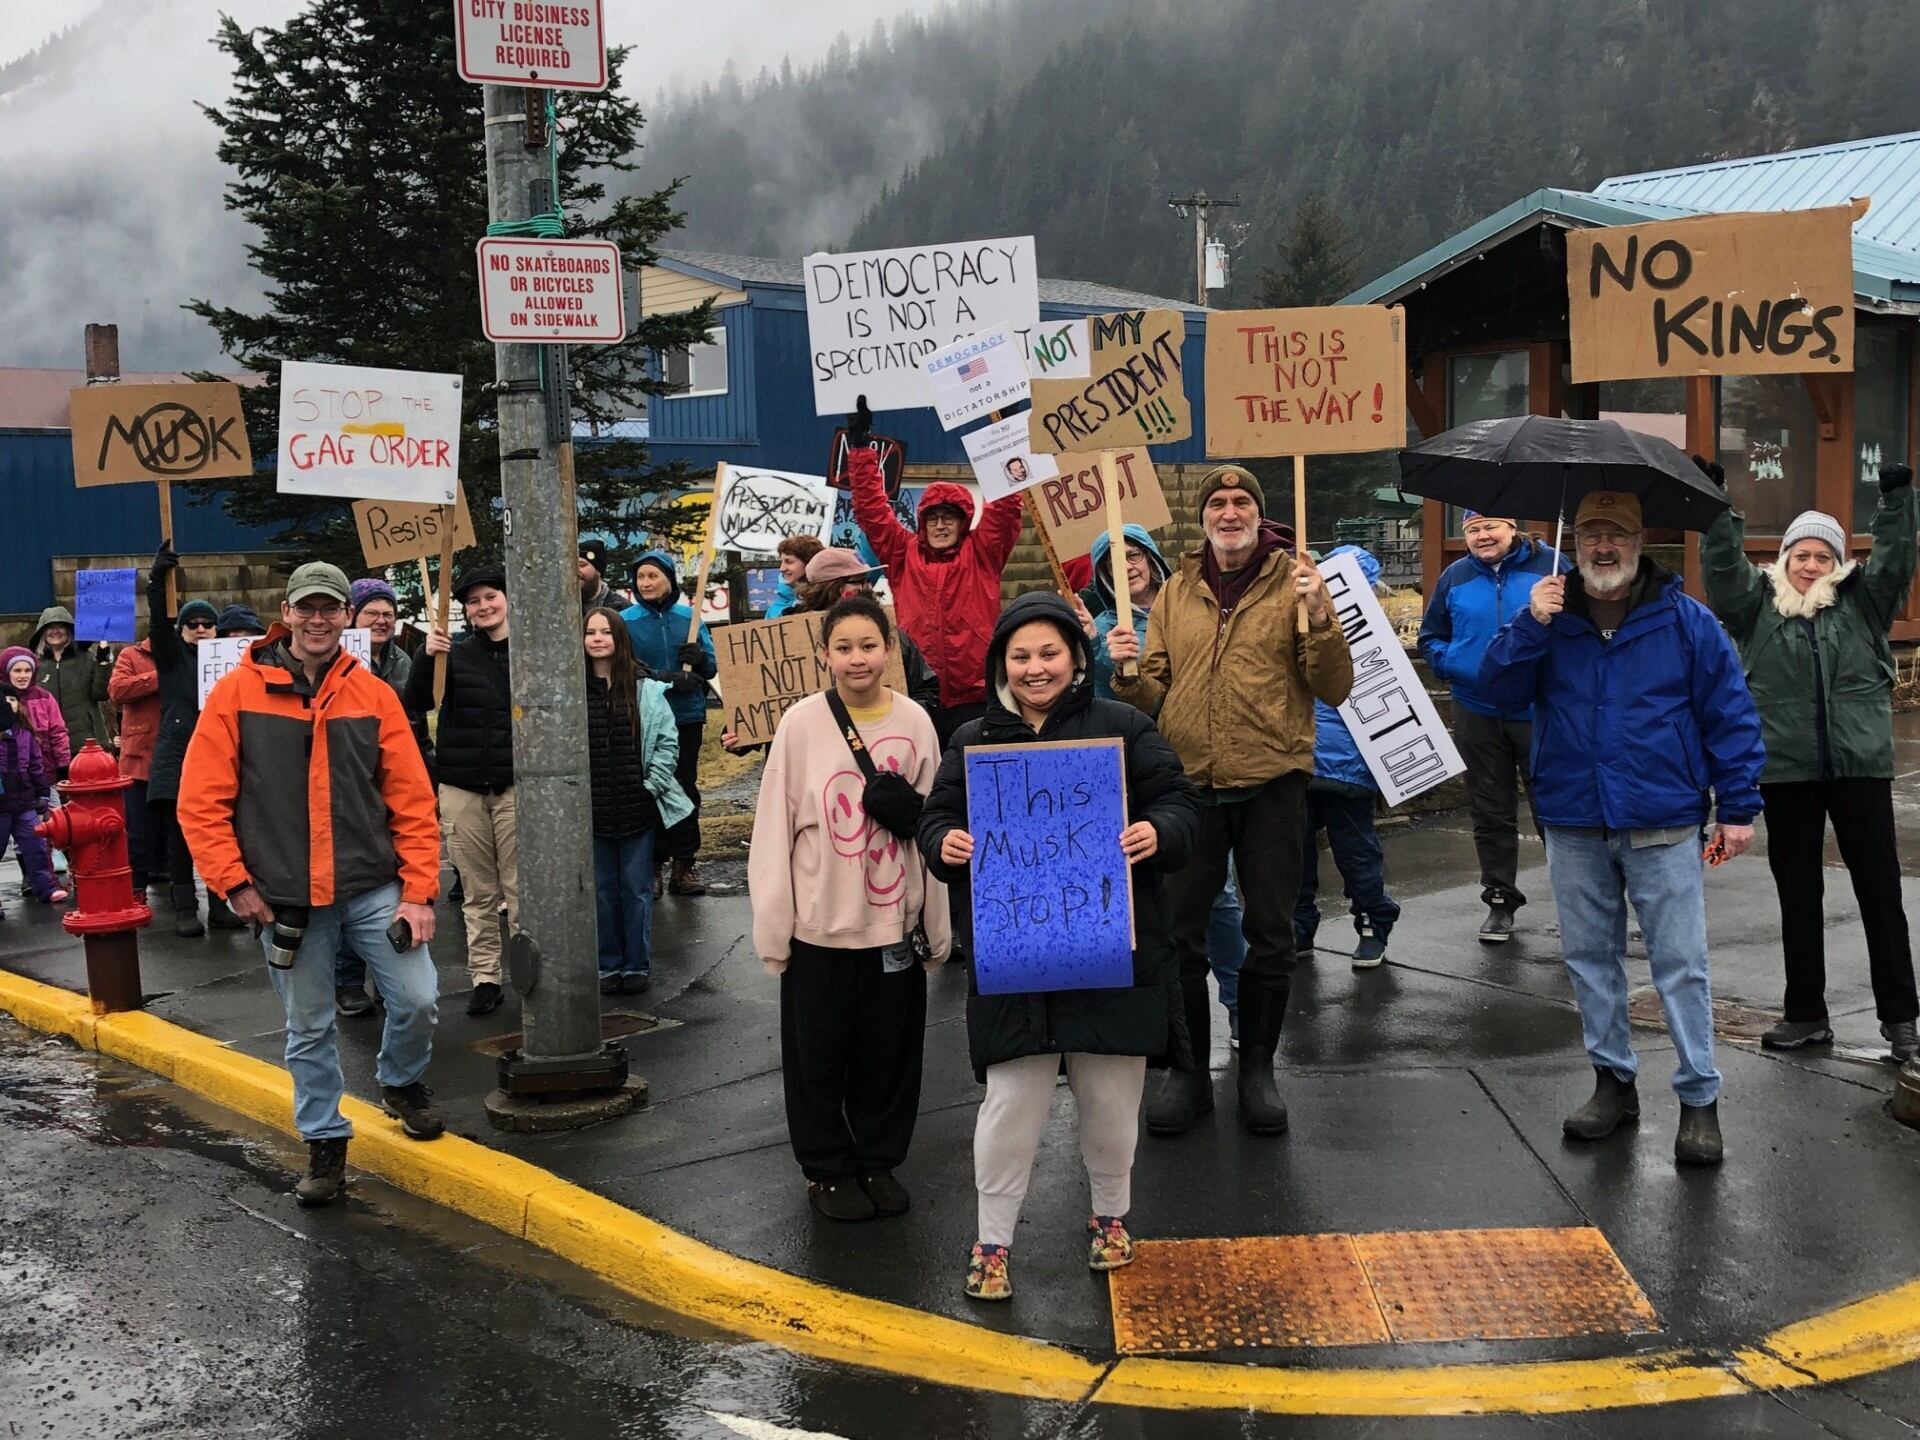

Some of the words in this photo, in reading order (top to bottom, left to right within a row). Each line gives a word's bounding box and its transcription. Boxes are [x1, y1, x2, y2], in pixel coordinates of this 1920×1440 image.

[471, 0, 505, 19] CITY
[514, 2, 590, 27] BUSINESS
[500, 24, 563, 47] LICENSE
[496, 45, 570, 69] REQUIRED
[490, 254, 509, 271] NO
[516, 256, 610, 274] SKATEBOARDS
[813, 245, 1018, 304] DEMOCRACY
[1590, 234, 1692, 298] NO
[510, 276, 527, 292] OR
[534, 277, 594, 293] BICYCLES
[525, 296, 583, 310] ALLOWED
[510, 312, 527, 326] ON
[534, 313, 598, 327] SIDEWALK
[847, 308, 872, 338] IS
[889, 299, 936, 332] NOT
[956, 295, 976, 323] A
[928, 334, 1006, 373] DEMOCRACY
[1034, 323, 1077, 372] NOT
[1093, 311, 1145, 350] MY
[1237, 326, 1308, 364] THIS
[1319, 329, 1345, 355] IS
[969, 382, 982, 393] not
[1042, 330, 1180, 451] PRESIDENT
[1274, 356, 1347, 392] NOT
[292, 388, 384, 422] STOP
[402, 396, 434, 411] THE
[944, 381, 1027, 421] DICTATORSHIP
[1235, 395, 1291, 423] THE
[1297, 386, 1361, 425] WAY
[98, 414, 241, 471] MUSK
[289, 433, 355, 470] GAG
[369, 434, 452, 469] ORDER
[732, 486, 829, 518] PRESIDENT
[1042, 453, 1138, 527] RESIT
[503, 508, 513, 536] 9
[728, 621, 795, 665] HATE
[760, 656, 806, 697] NOT
[976, 758, 1090, 823] This
